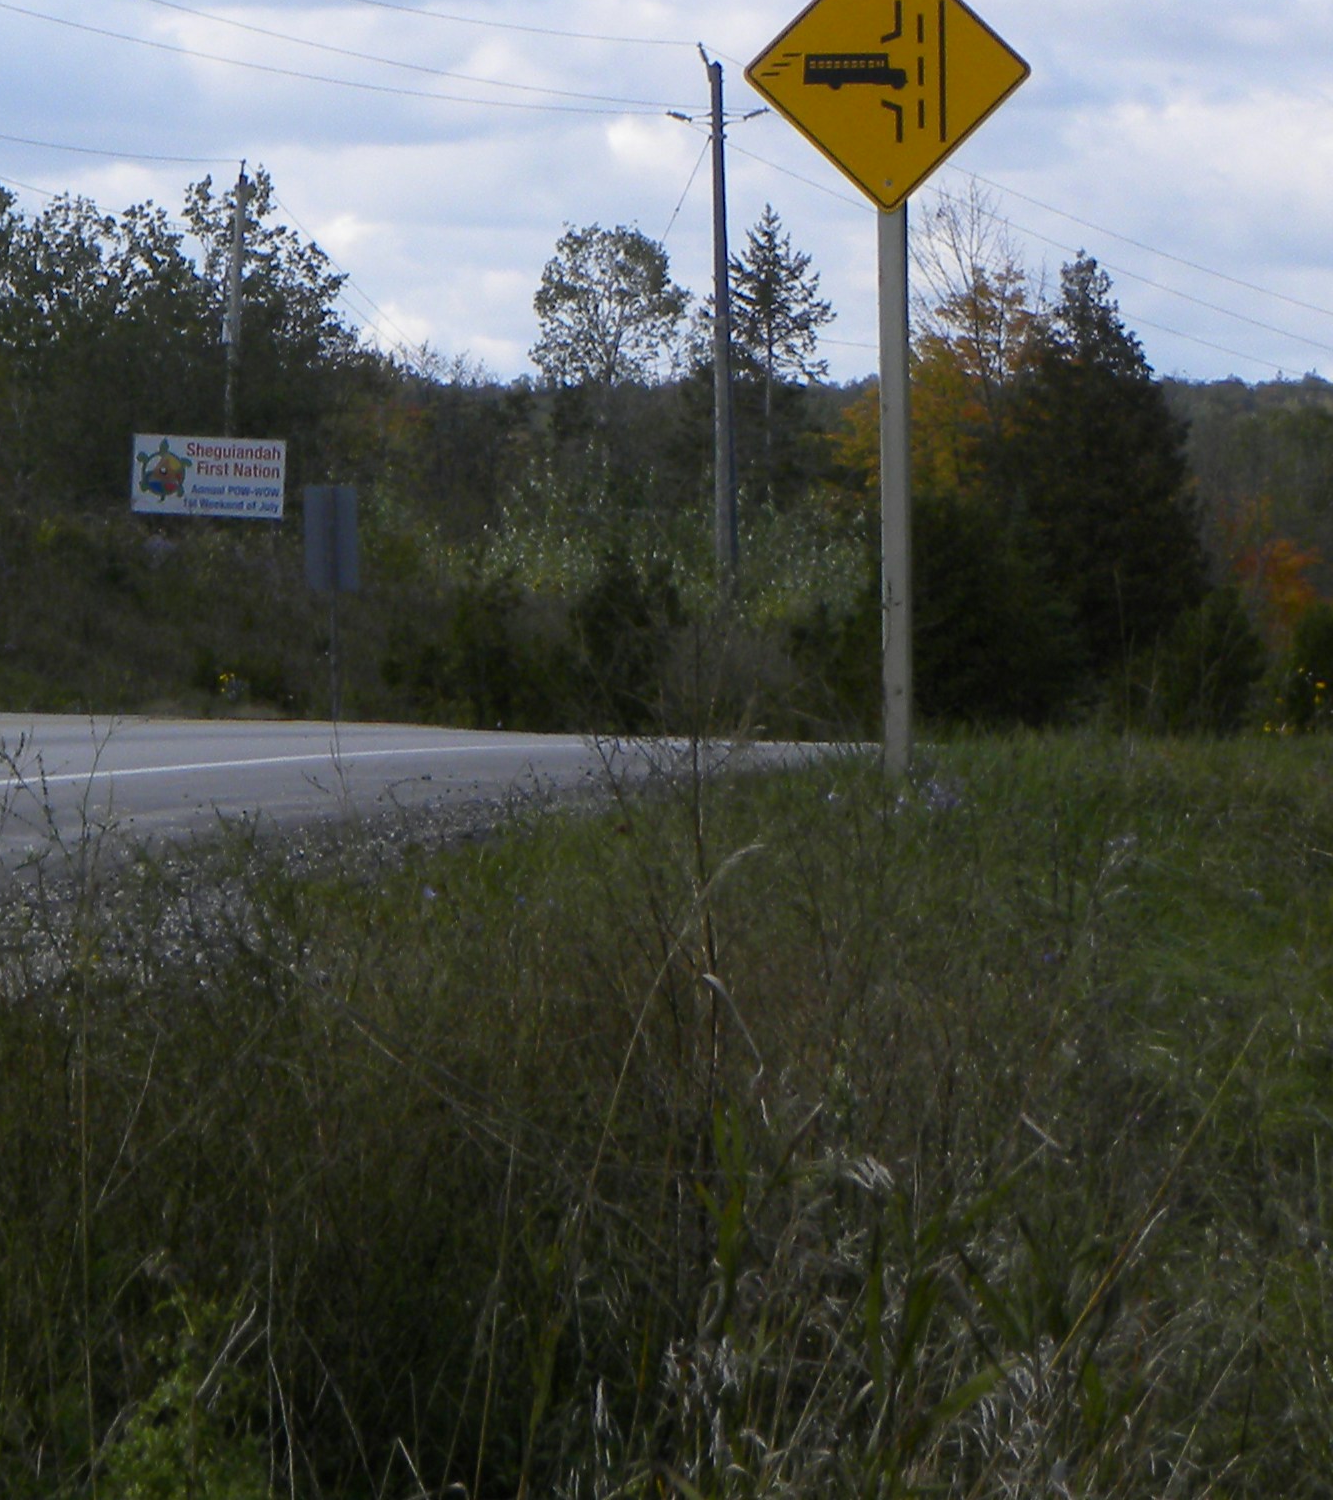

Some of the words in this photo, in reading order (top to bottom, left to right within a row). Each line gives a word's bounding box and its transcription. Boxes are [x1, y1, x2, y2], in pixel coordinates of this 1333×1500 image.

[186, 442, 281, 461] Sheguiandah
[196, 460, 230, 477] First
[233, 462, 280, 479] Nation
